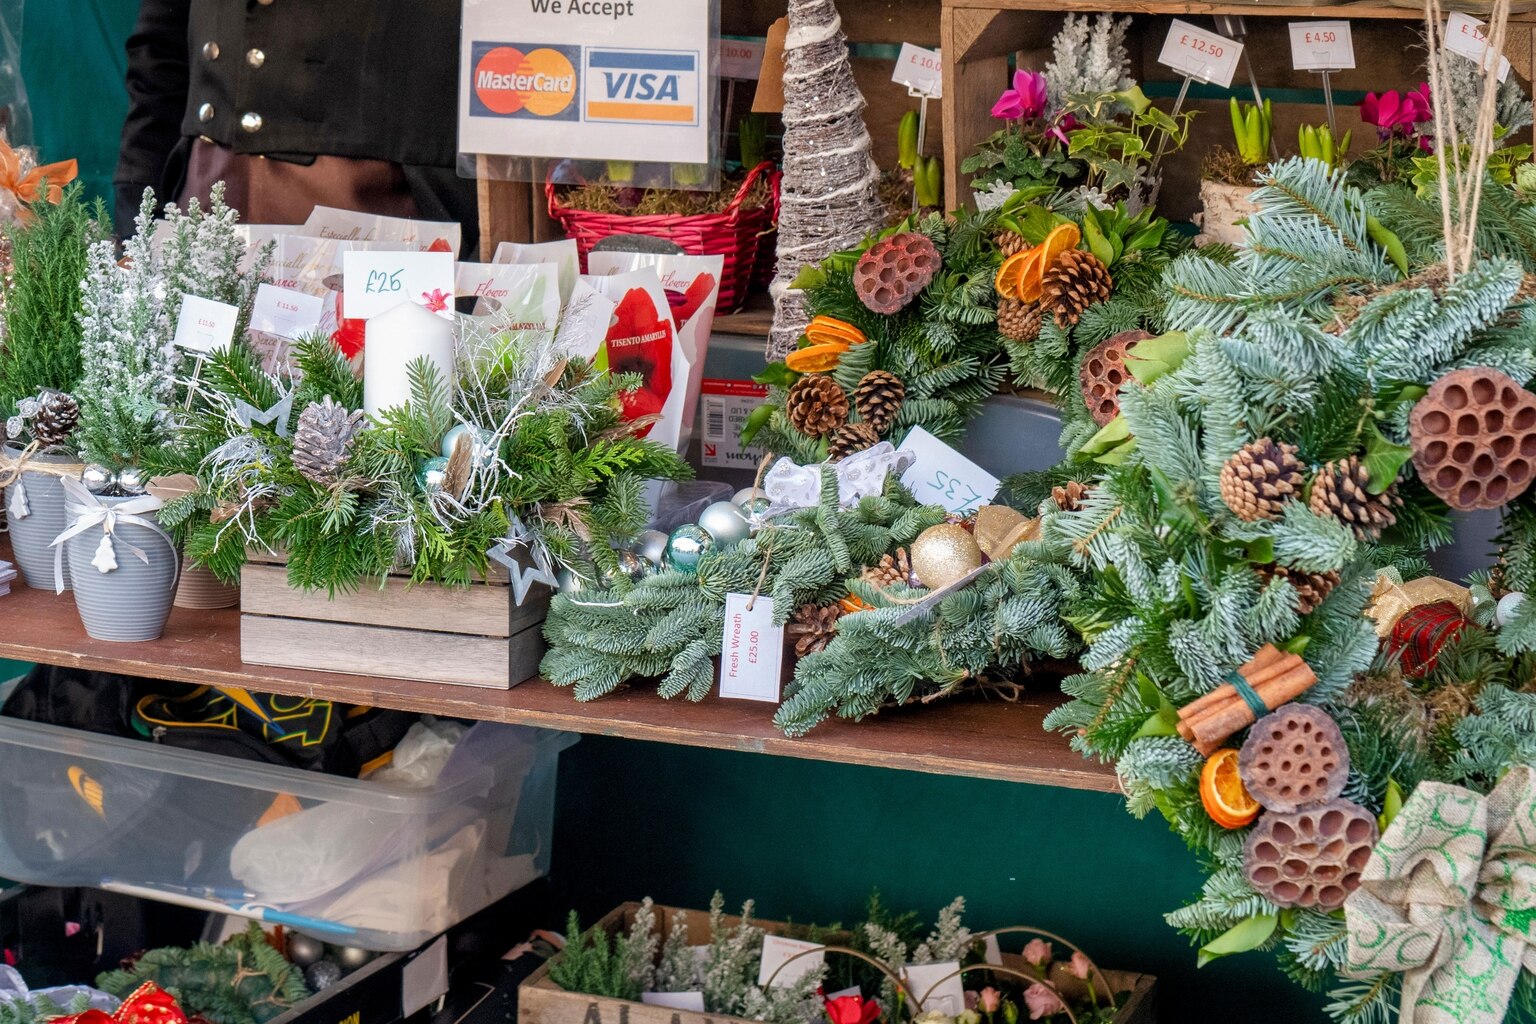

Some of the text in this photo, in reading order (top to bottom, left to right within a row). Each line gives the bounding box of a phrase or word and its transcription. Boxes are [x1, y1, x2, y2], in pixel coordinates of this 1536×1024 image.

[1314, 32, 1336, 43] 4.50
[1190, 38, 1224, 58] 12.50
[920, 55, 942, 72] 10.0
[476, 70, 573, 94] MasterCard
[601, 71, 680, 101] VISA
[474, 278, 509, 297] Flowers
[611, 329, 666, 348] TISENTO AMARYLLIS
[729, 613, 742, 678] Fresh Wreath
[749, 631, 759, 664] £25.00
